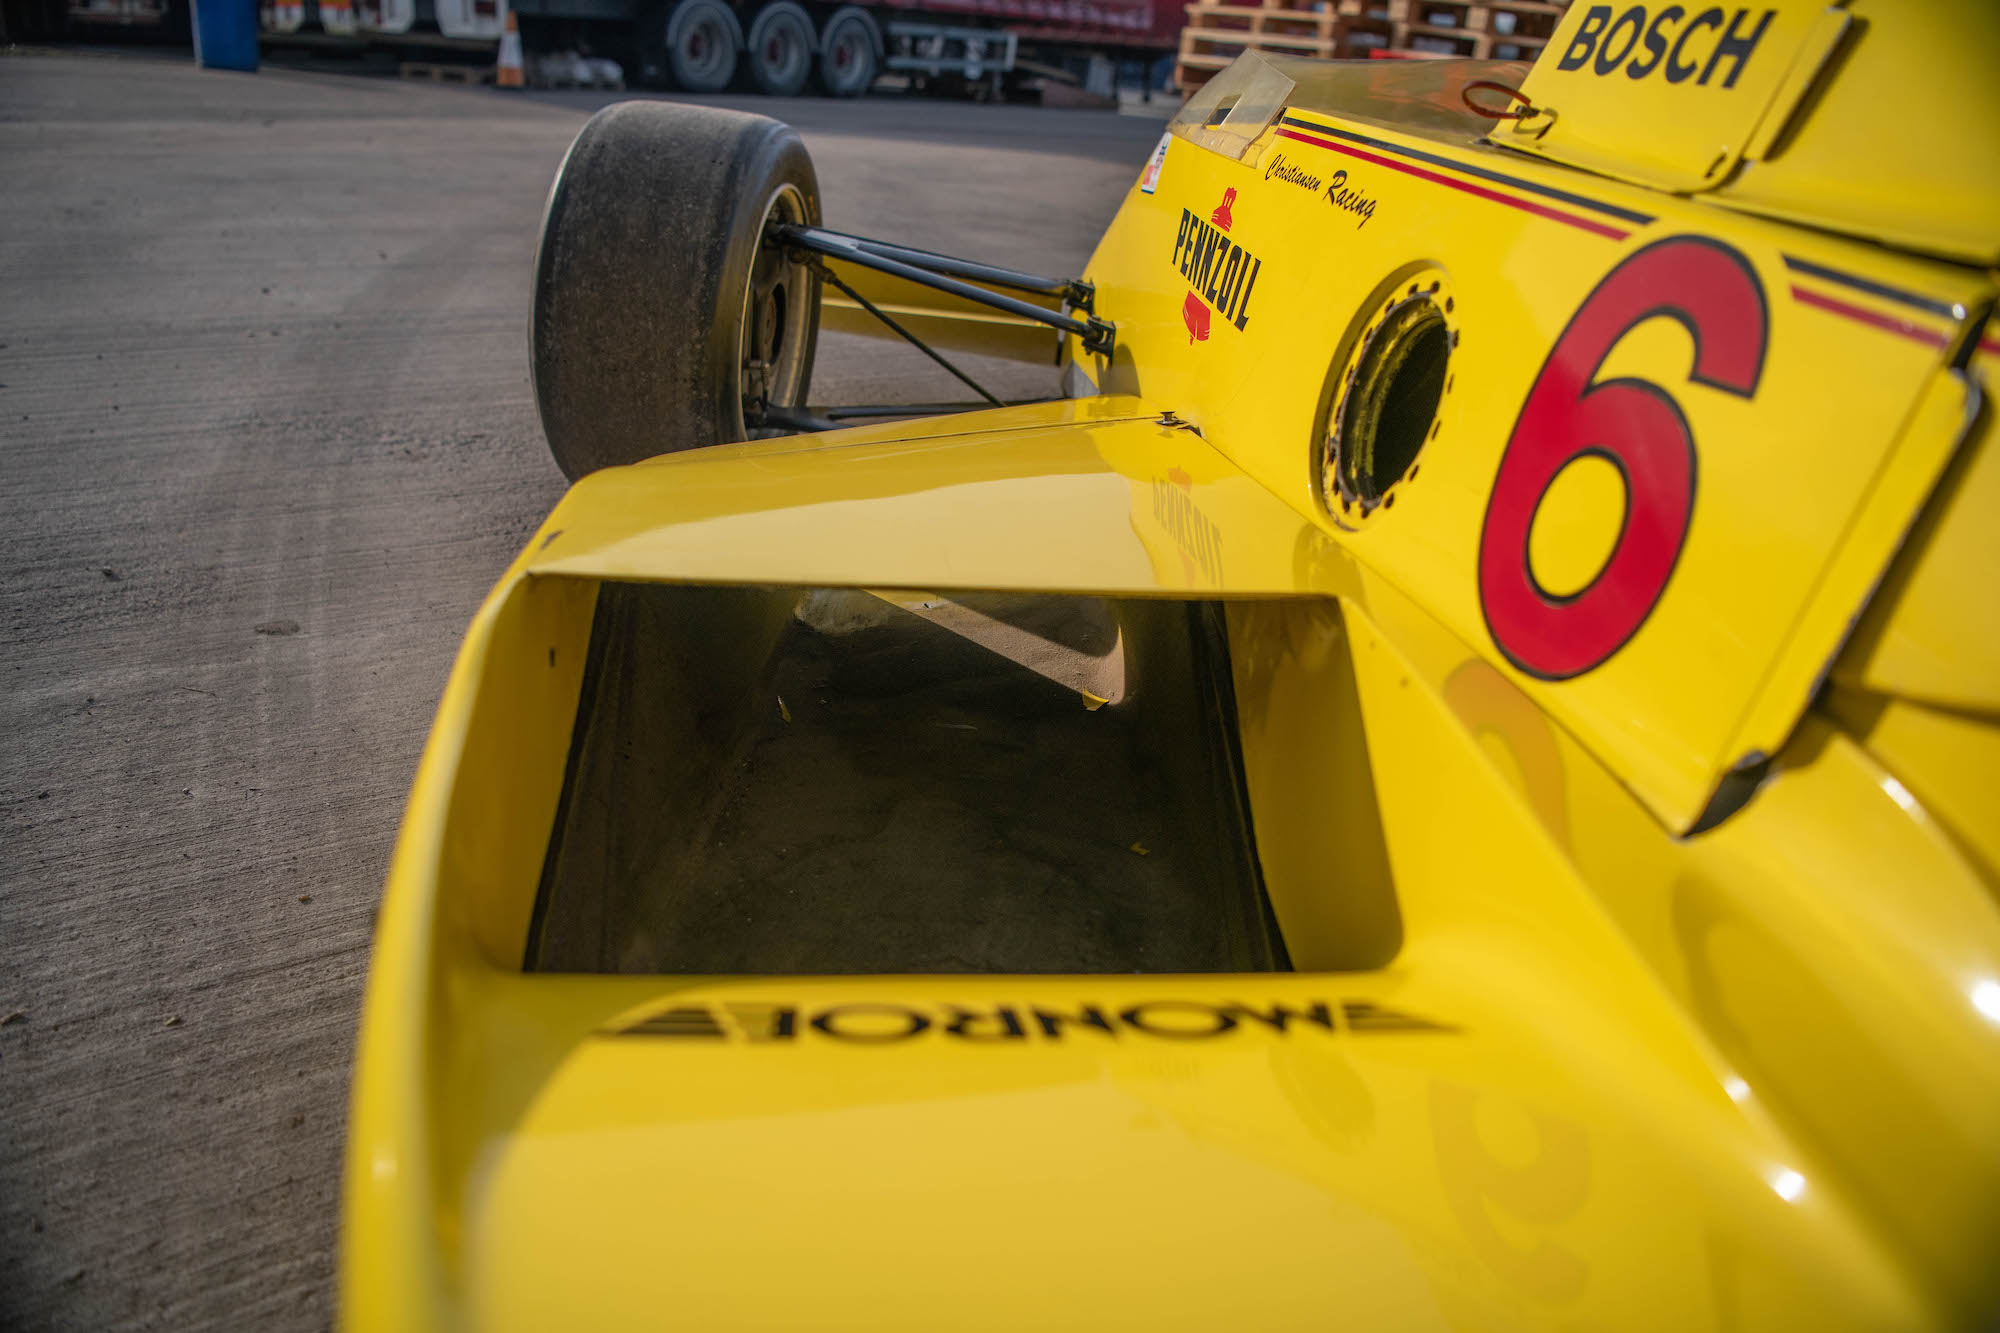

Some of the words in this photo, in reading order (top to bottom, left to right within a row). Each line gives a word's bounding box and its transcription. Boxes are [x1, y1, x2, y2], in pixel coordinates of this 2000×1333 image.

[1557, 5, 1777, 89] BOSCH
[1264, 153, 1322, 192] Christiansen
[1323, 169, 1378, 230] Racing
[1171, 207, 1262, 333] PENNZOIL
[1477, 233, 1770, 683] 6
